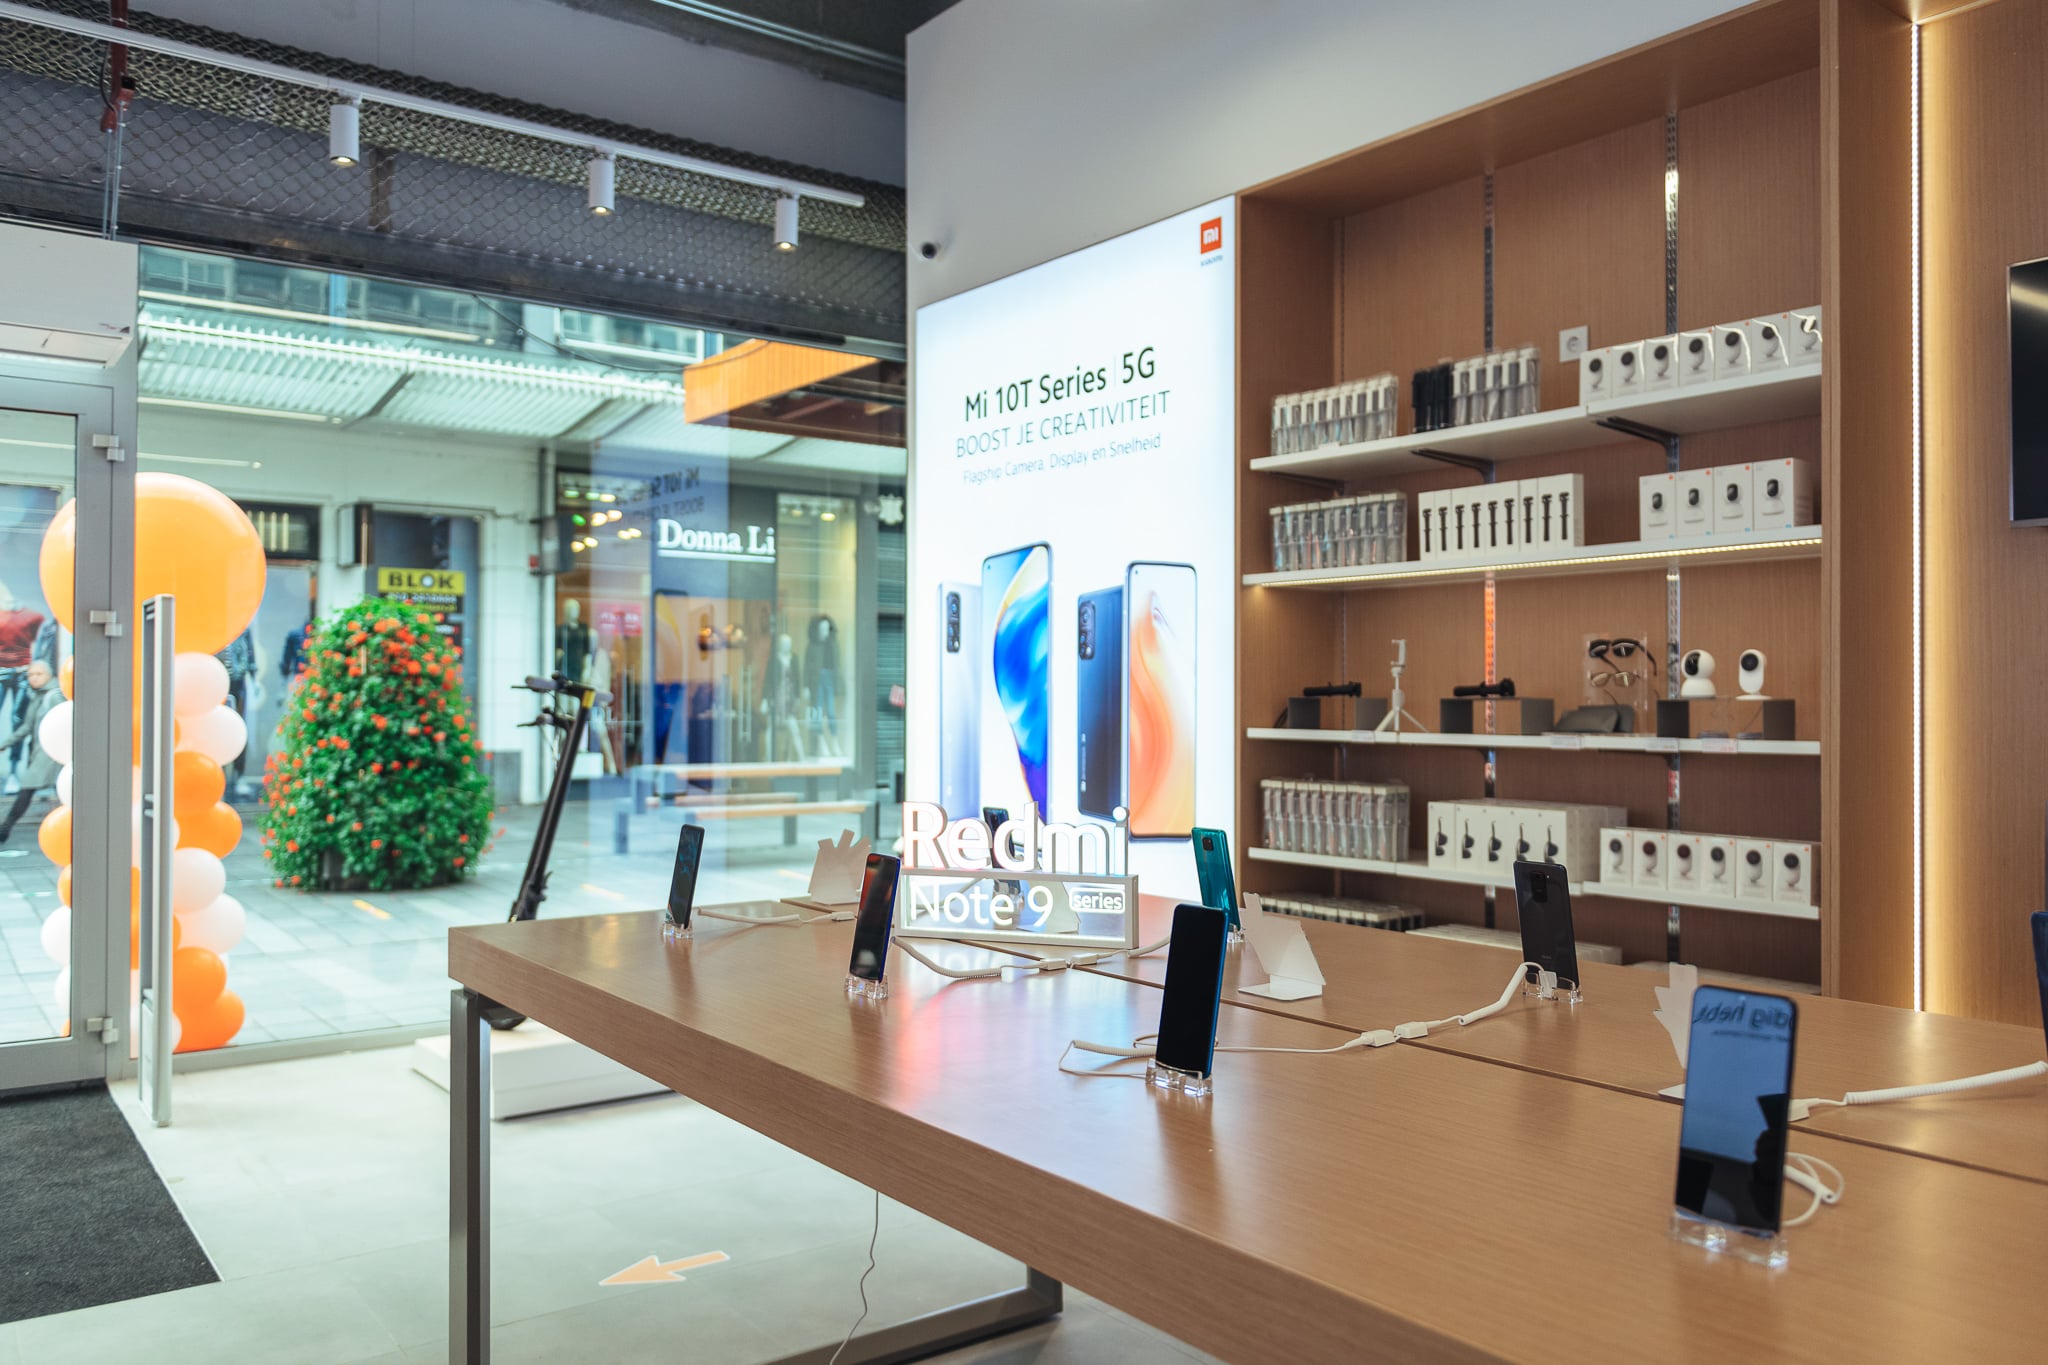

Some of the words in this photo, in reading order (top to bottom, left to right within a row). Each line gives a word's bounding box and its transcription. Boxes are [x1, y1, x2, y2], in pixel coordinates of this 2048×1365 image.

[965, 390, 988, 422] Mi
[996, 379, 1033, 413] 10T
[1039, 365, 1107, 404] Series
[1122, 347, 1155, 384] 5G
[956, 427, 1011, 458] BOOST
[1016, 422, 1035, 446] JE
[1039, 390, 1171, 440] CREATIVITEIT
[963, 465, 1002, 486] Flagship
[1050, 450, 1088, 471] Display
[1091, 447, 1106, 461] en
[1109, 433, 1162, 457] Snelheid
[657, 518, 744, 553] Donna
[747, 525, 777, 555] Li
[388, 571, 455, 589] BLOK
[902, 800, 1130, 877] Redmi
[910, 876, 1015, 926] Note
[1027, 885, 1055, 927] 9
[1072, 891, 1123, 911] series
